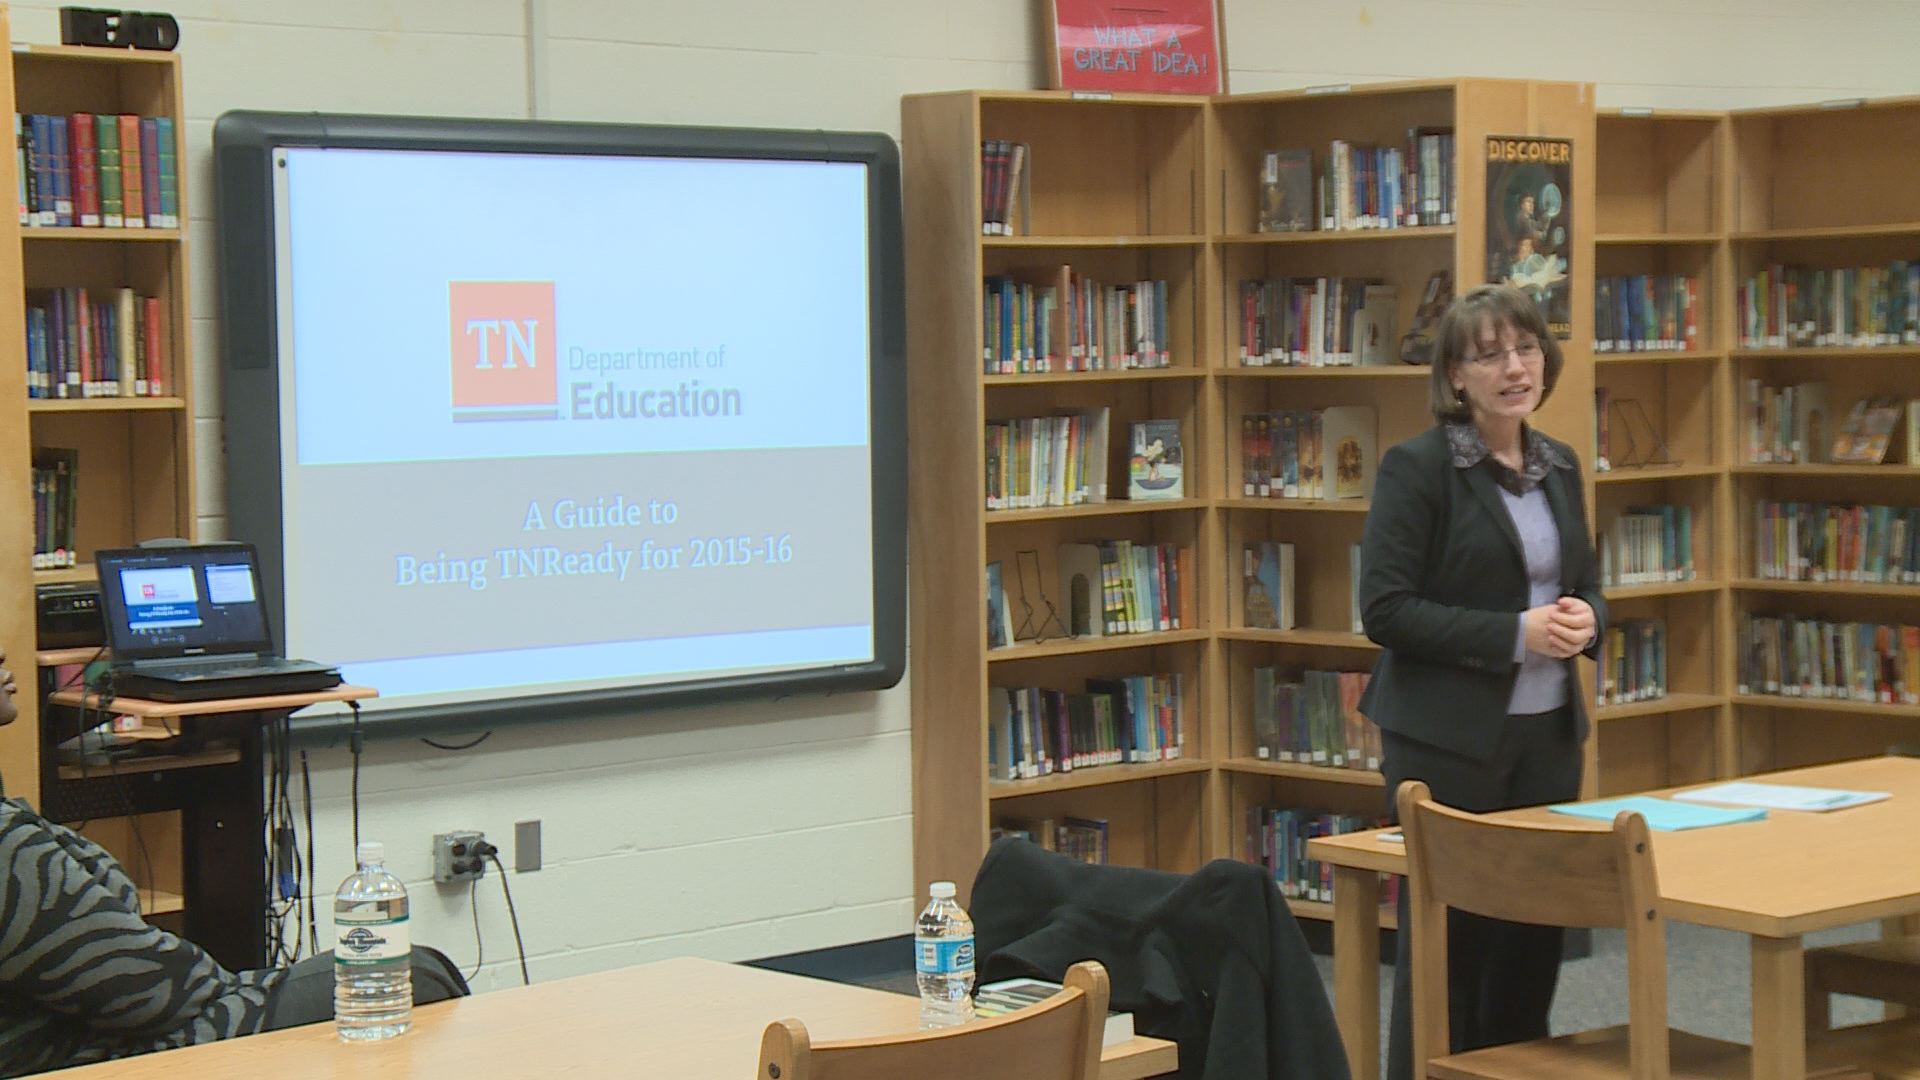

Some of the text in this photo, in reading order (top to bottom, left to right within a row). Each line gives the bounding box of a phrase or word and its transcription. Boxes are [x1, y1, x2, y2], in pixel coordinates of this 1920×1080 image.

[1093, 25, 1181, 48] WHAT A
[1073, 47, 1208, 76] GREAT IDEA!
[1489, 139, 1569, 161] DISCOVER
[465, 318, 538, 369] TN
[568, 344, 726, 377] Department of
[570, 380, 742, 420] Education
[522, 495, 678, 531] A Guide to
[395, 533, 793, 591] Being TNReady for 2015-16
